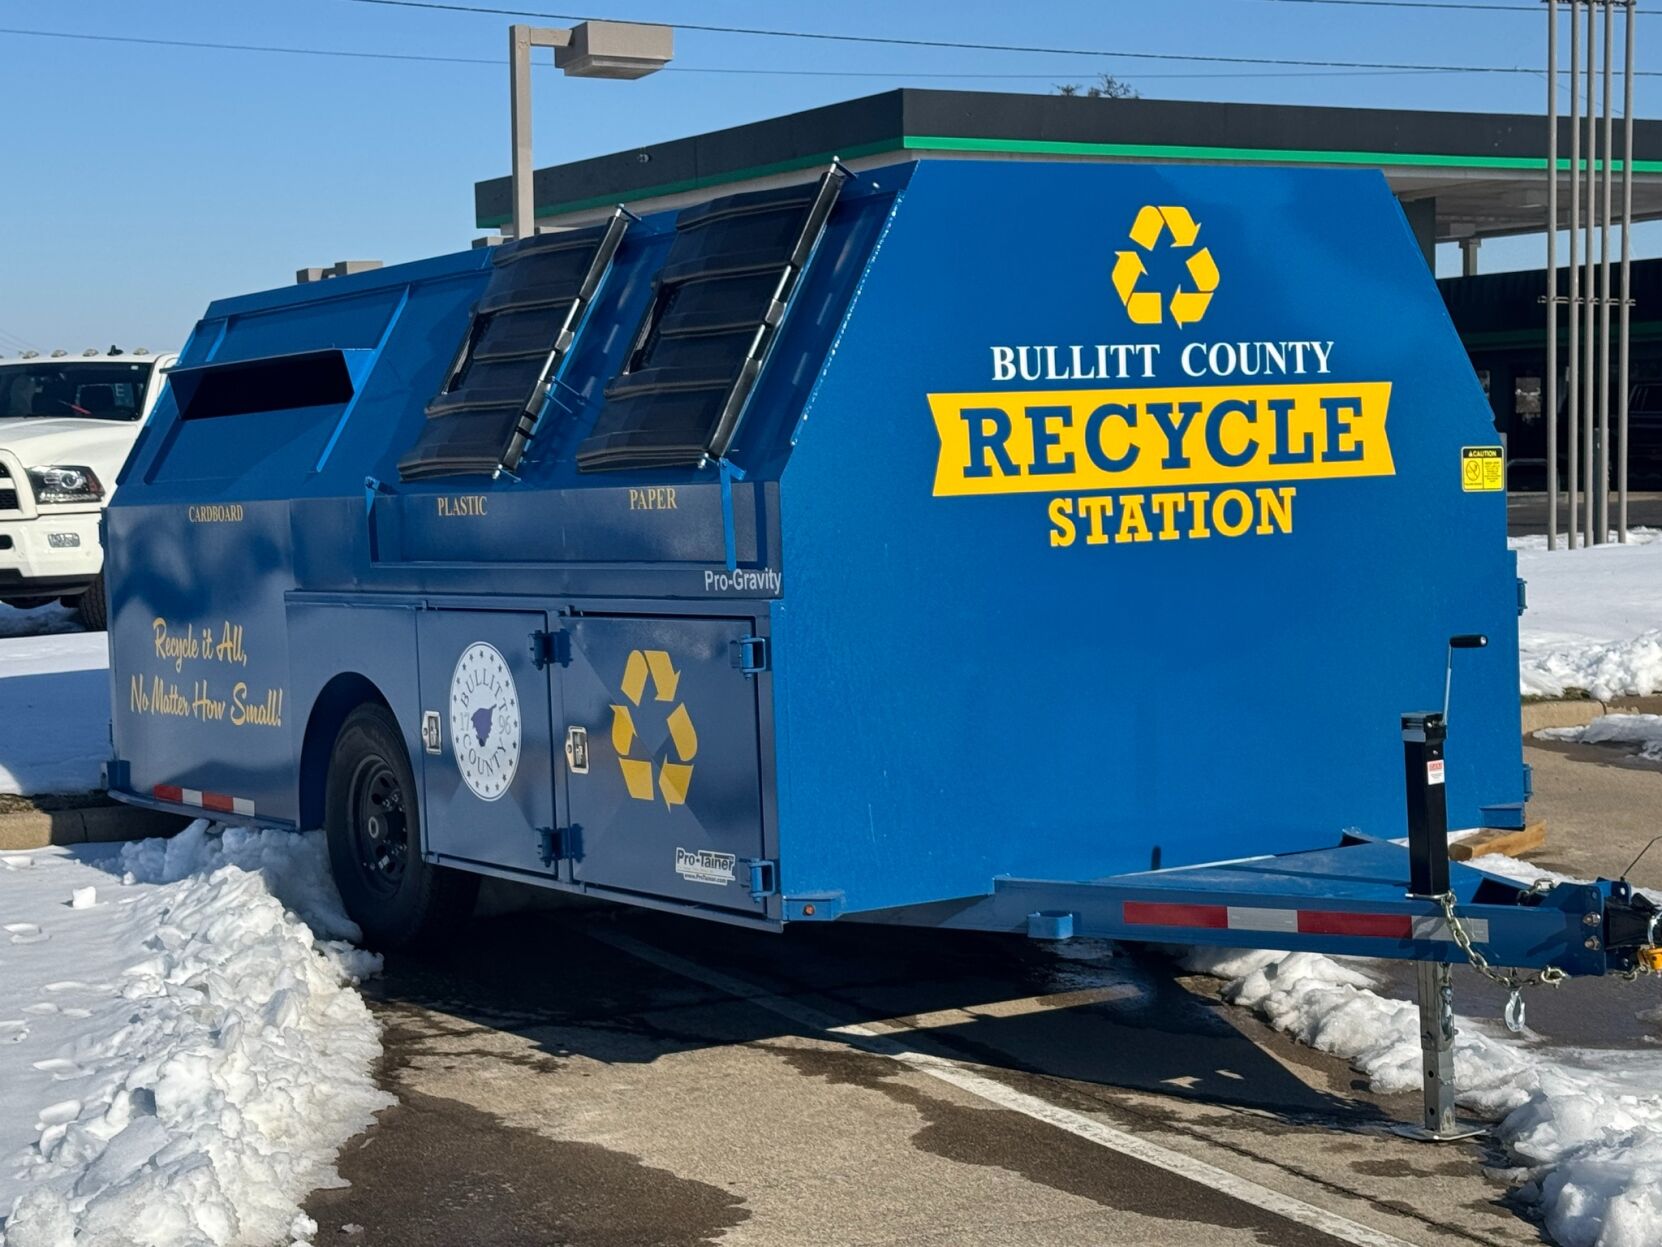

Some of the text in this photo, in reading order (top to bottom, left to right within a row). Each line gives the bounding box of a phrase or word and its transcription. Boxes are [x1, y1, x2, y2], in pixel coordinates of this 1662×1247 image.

[990, 340, 1334, 381] BULLITT COUNTY
[960, 396, 1365, 479] RECYCLE
[188, 504, 243, 523] CARDBOARD
[437, 495, 488, 517] PLASTIC
[629, 487, 678, 511] PAPER
[1049, 487, 1297, 547] STATION
[704, 567, 782, 593] Pro-Gravity
[153, 617, 247, 673] Recycle it All,
[131, 673, 283, 728] No Matter How Small!
[460, 668, 507, 714] BULLITT
[462, 733, 507, 777] COUNTY
